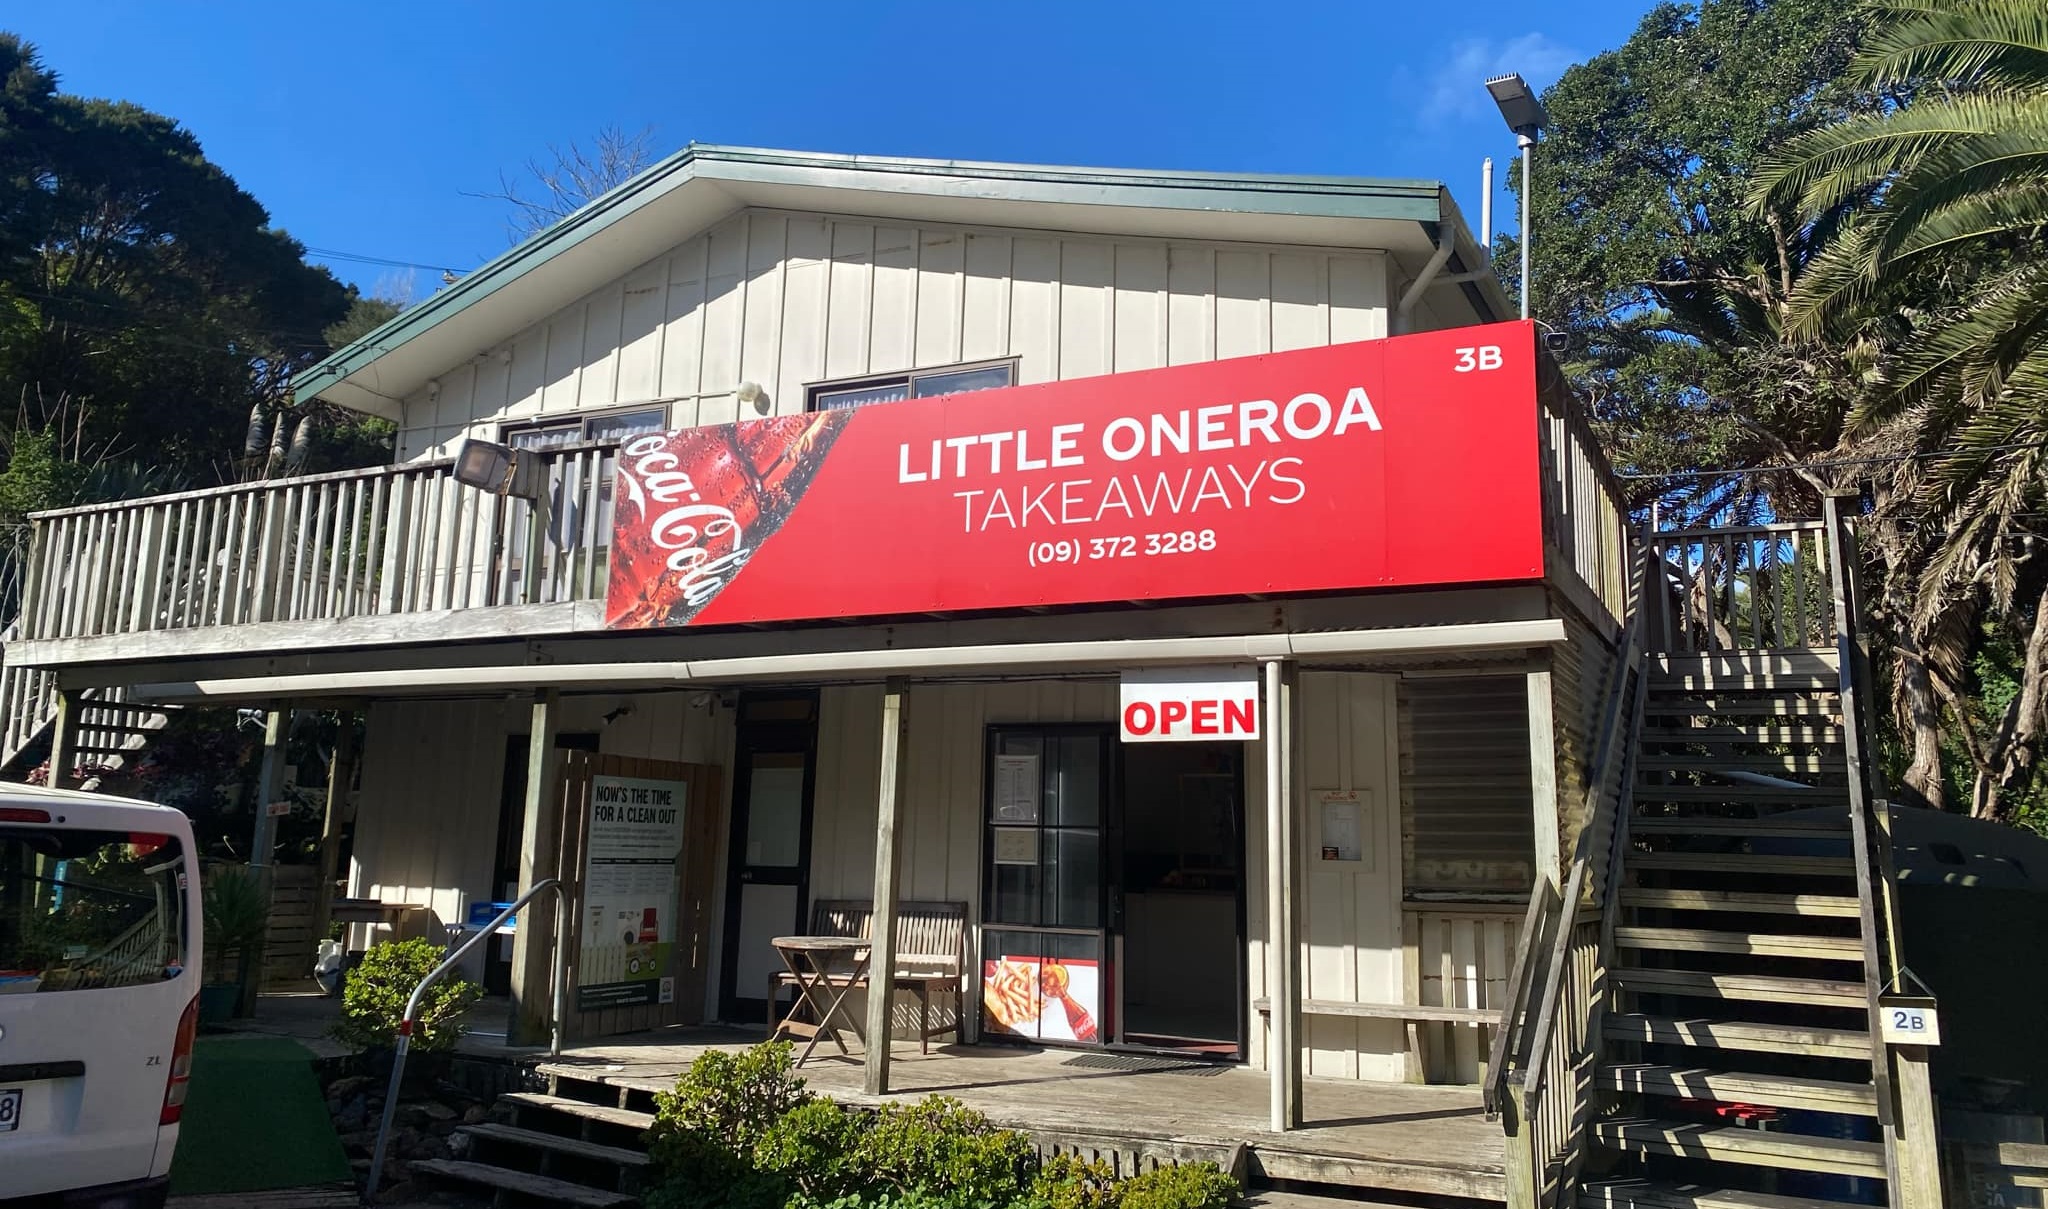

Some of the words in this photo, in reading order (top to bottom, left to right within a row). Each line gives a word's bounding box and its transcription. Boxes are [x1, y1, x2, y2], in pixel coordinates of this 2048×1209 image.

[1454, 345, 1503, 373] 3B
[899, 422, 1085, 484] LITTLE
[1101, 386, 1383, 462] ONEROA
[953, 456, 1306, 533] TAKEAWAYS
[1028, 538, 1081, 567] (09)
[1089, 535, 1136, 560] 372
[1144, 529, 1217, 556] 3288
[1124, 699, 1255, 736] OPEN
[596, 786, 628, 803] NOW'S
[631, 788, 649, 804] THE
[651, 789, 672, 805] TIME
[594, 806, 614, 822] FOR
[617, 807, 624, 822] A
[627, 807, 656, 824] CLEAN
[658, 809, 677, 824] OUT
[1894, 1011, 1924, 1030] 2B
[146, 1056, 161, 1067] ZL
